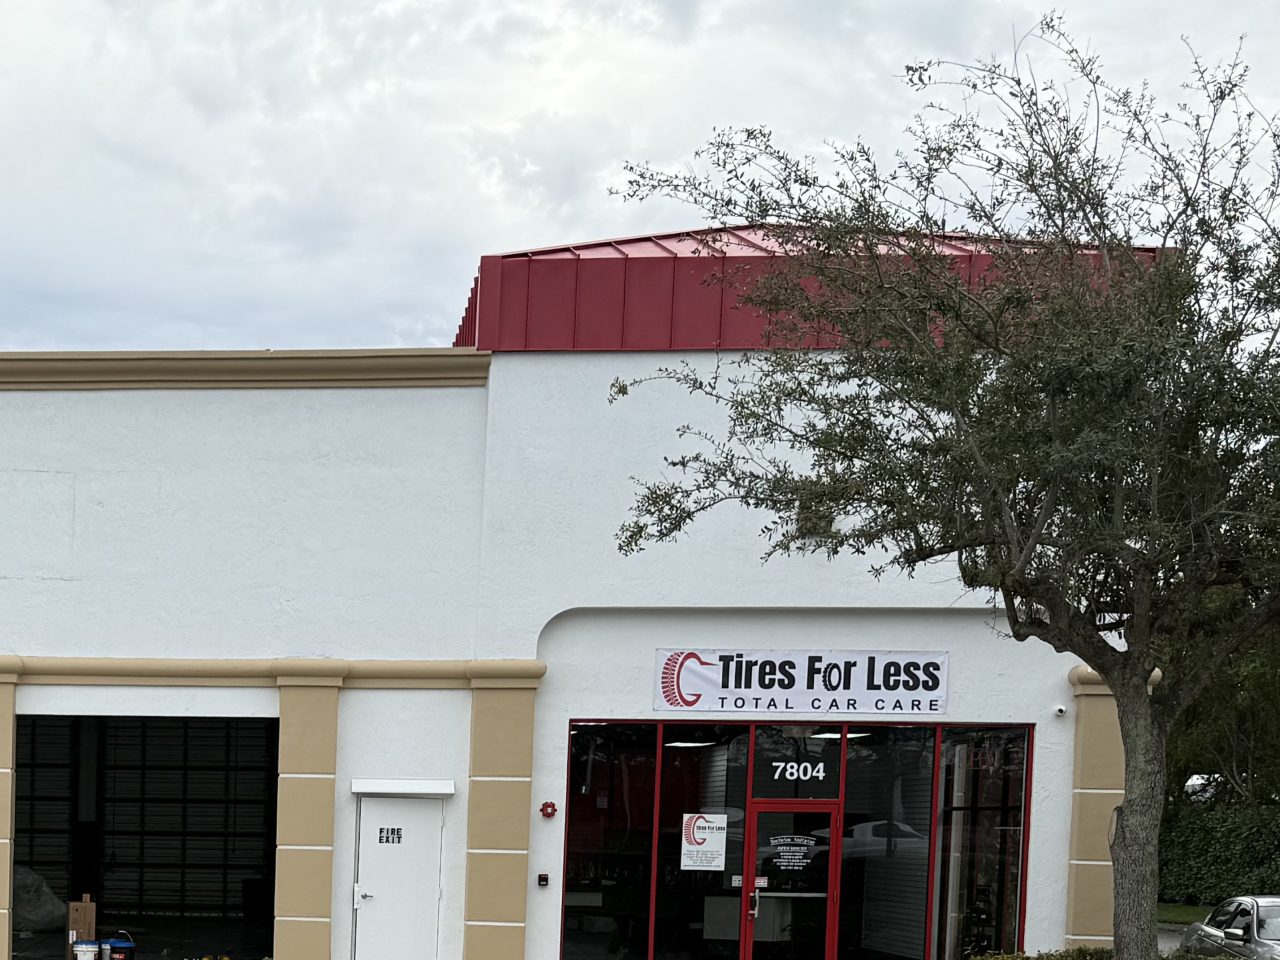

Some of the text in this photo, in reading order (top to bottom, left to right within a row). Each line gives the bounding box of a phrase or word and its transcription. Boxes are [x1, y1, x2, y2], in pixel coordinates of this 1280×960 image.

[719, 653, 941, 692] Tires For Less
[718, 697, 939, 712] TOTAL CAR CARE
[772, 762, 826, 781] 7804
[379, 827, 402, 836] FIRE
[379, 836, 402, 844] EXIT
